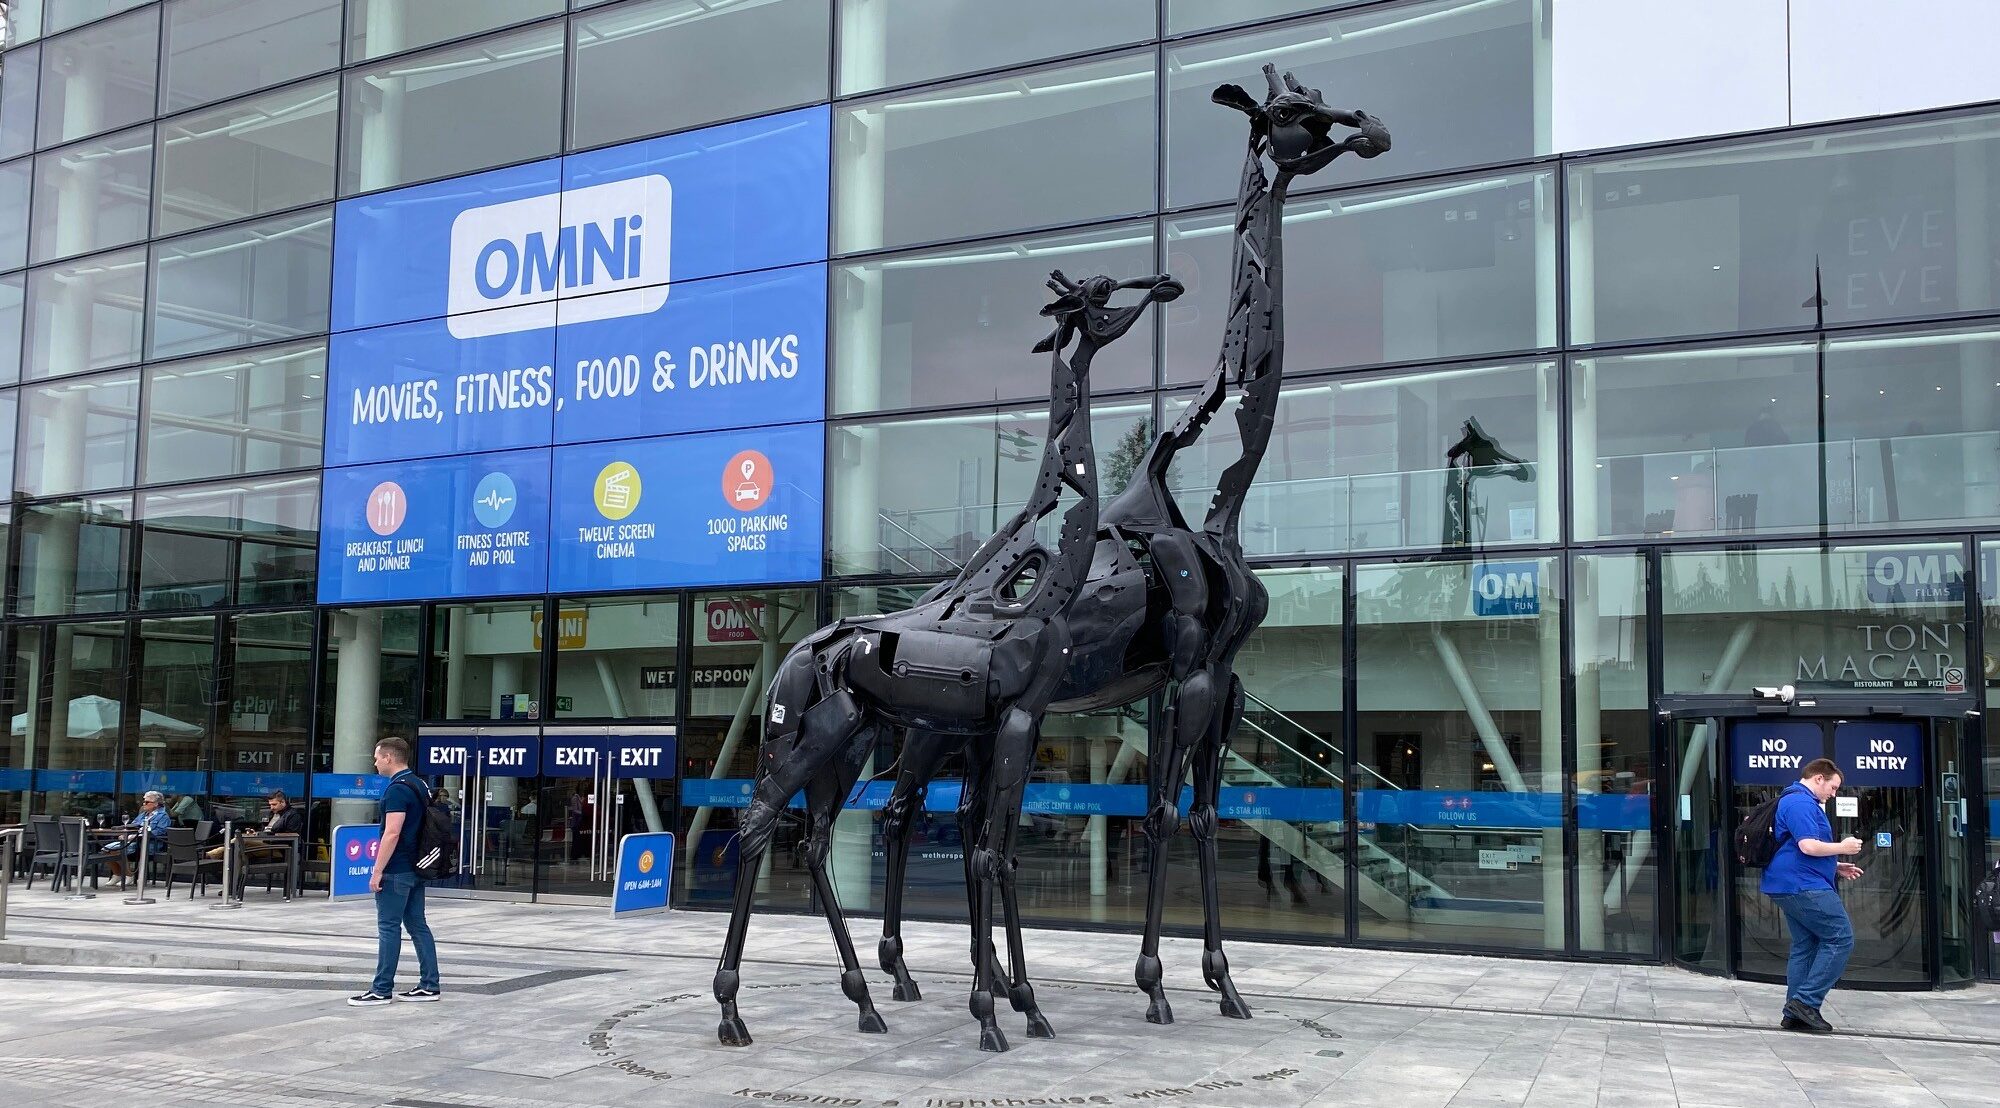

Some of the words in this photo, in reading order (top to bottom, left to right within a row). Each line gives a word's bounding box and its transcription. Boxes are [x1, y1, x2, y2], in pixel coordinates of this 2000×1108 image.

[1848, 209, 1945, 257] EVE
[1847, 264, 1942, 310] EVE
[576, 354, 640, 401] FOOD
[652, 350, 677, 393] &
[579, 525, 615, 543] TWELVE
[619, 523, 655, 541] SCREEN
[707, 518, 736, 535] 1000
[347, 540, 394, 557] BREAKFAST,
[397, 538, 424, 553] LUNCH
[496, 531, 530, 548] CENTRE
[727, 534, 766, 552] SPACES
[358, 557, 376, 572] AND
[470, 551, 489, 567] AND
[493, 549, 516, 565] POOL
[1479, 572, 1534, 600] OM
[1915, 588, 1950, 597] FILMS
[1514, 602, 1534, 610] FUN
[646, 668, 752, 684] WETRSPOON
[1762, 738, 1788, 753] NO
[1870, 739, 1894, 753] NO
[238, 751, 274, 764] EXIT
[430, 746, 466, 764] EXIT
[489, 747, 527, 765] EXIT
[556, 747, 595, 765] EXIT
[621, 748, 662, 766] EXIT
[1749, 755, 1802, 769] ENTRY
[1856, 756, 1907, 770] ENTRY
[1235, 806, 1251, 815] STAR
[1252, 806, 1272, 816] HOTEL
[1438, 811, 1465, 820] FOLLOW
[1467, 812, 1477, 821] US
[922, 851, 964, 860] wetherspo
[348, 866, 370, 876] FOLLOW
[624, 880, 638, 891] OPEN
[1124, 1087, 1193, 1101] with
[1194, 1079, 1243, 1092] his
